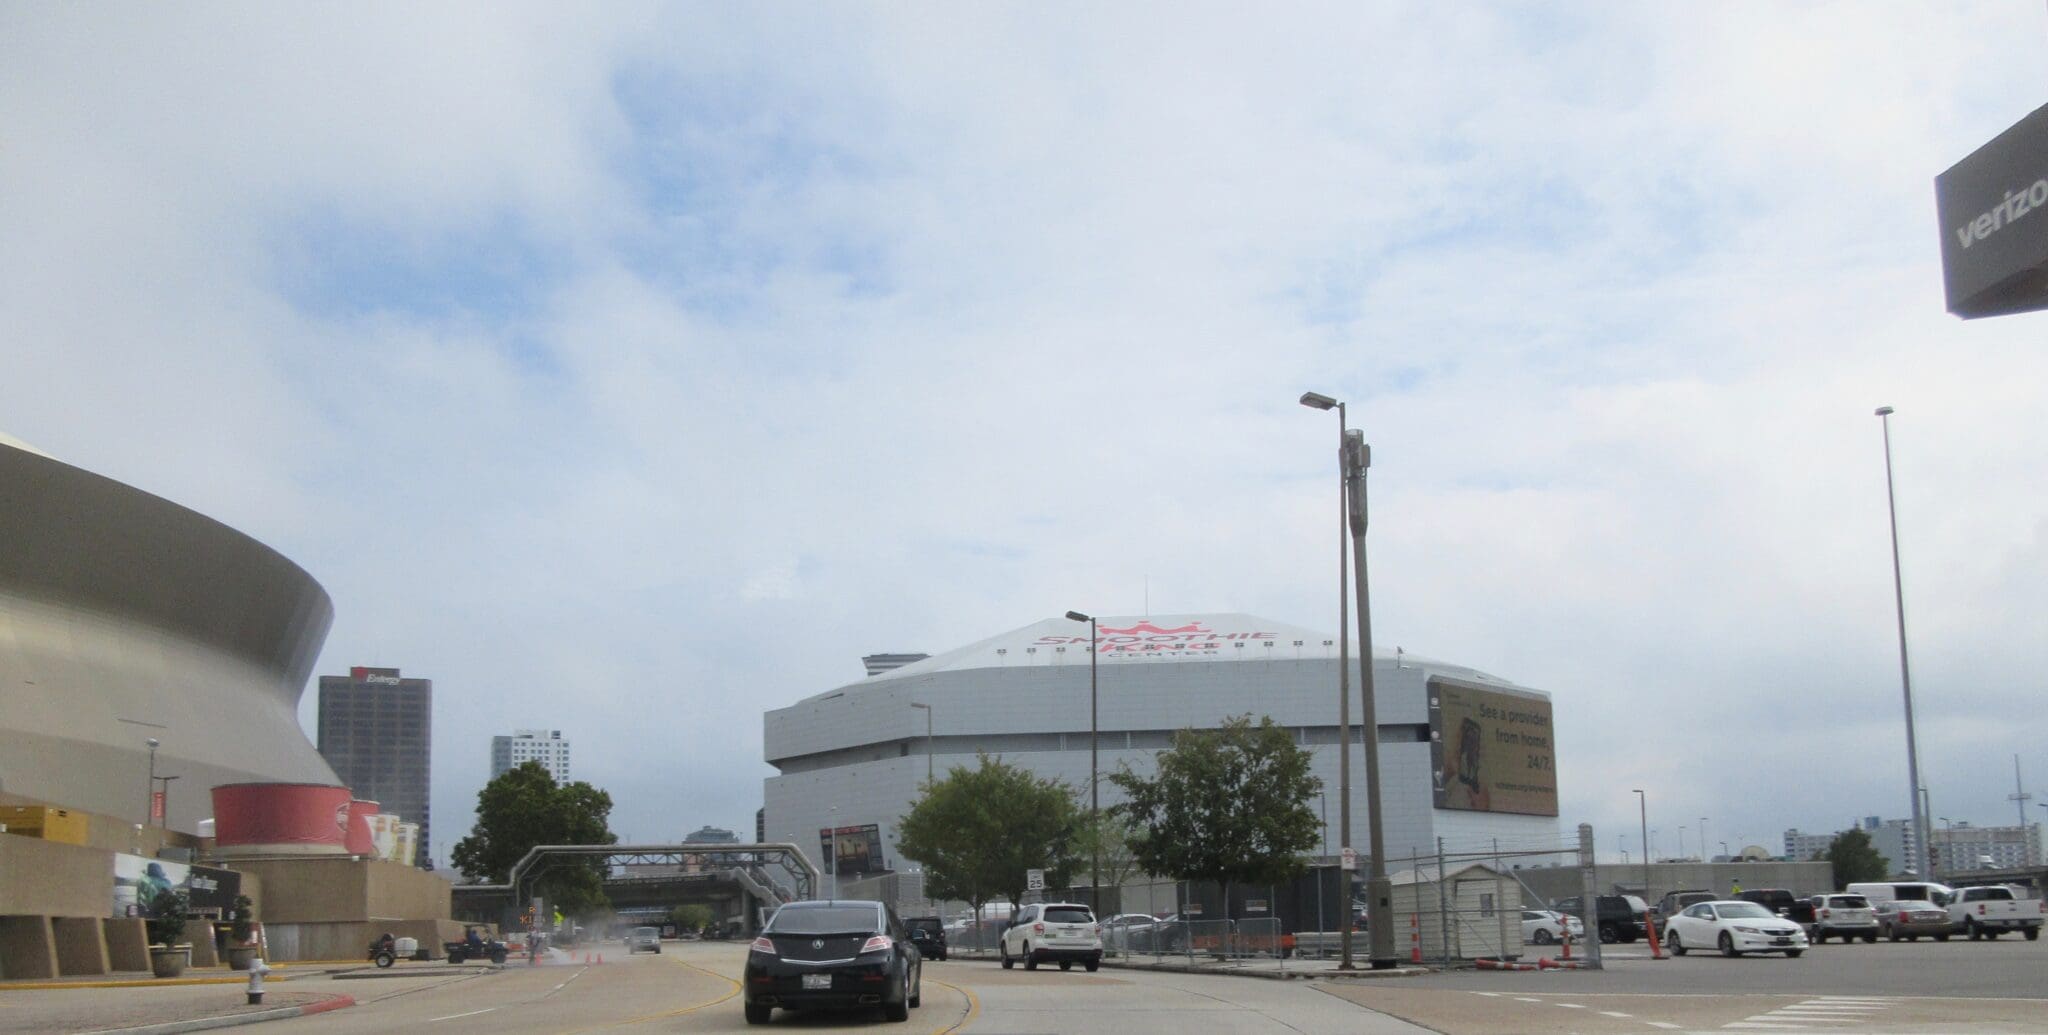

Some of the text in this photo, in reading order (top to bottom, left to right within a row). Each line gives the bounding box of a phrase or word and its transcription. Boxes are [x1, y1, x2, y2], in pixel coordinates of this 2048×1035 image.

[1957, 180, 2048, 248] verizo
[1033, 632, 1278, 646] SMOOTHIE
[1098, 643, 1221, 653] KING
[1480, 704, 1548, 726] See a provider
[1496, 728, 1519, 744] from
[1030, 880, 1042, 888] 25
